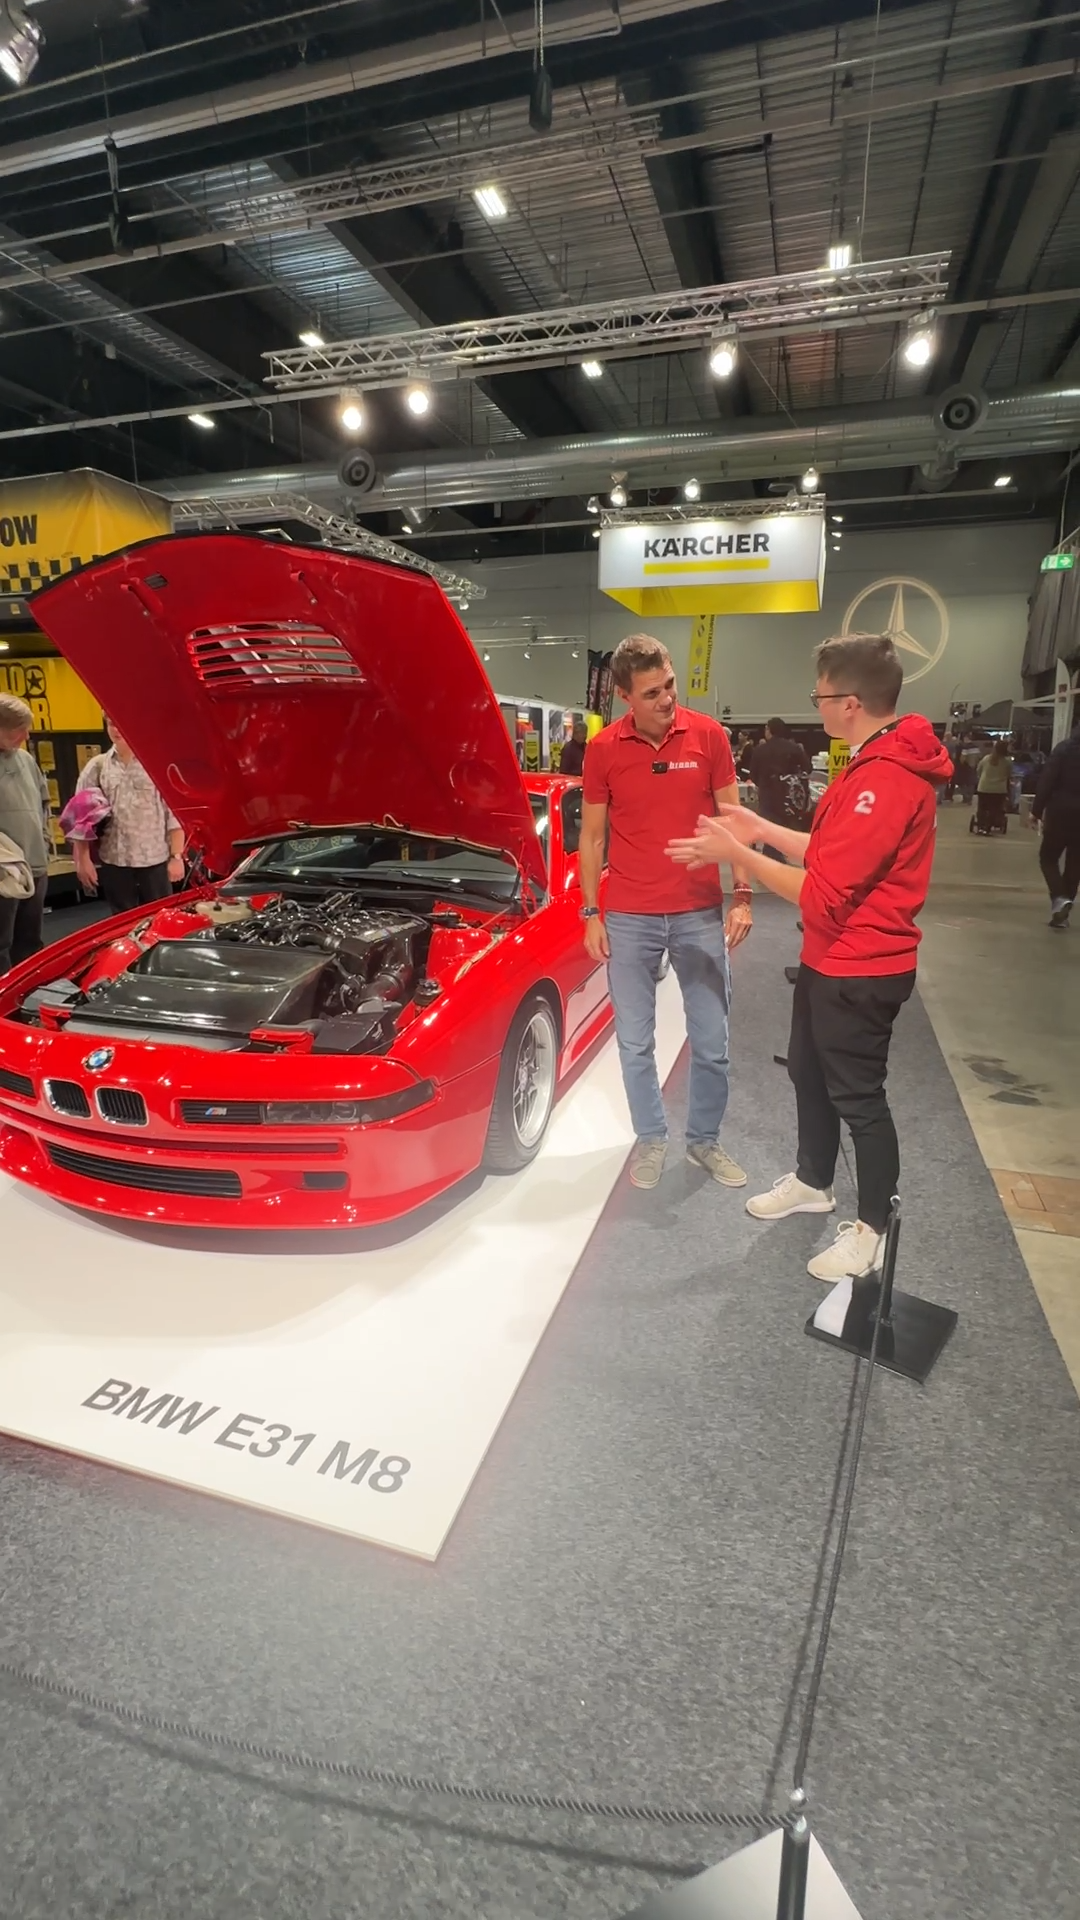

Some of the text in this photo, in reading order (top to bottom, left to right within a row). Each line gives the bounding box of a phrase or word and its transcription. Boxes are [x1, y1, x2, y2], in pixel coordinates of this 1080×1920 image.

[643, 532, 771, 558] KÄRCHER
[853, 790, 876, 814] 2
[80, 1378, 411, 1494] BMW E31 M8
